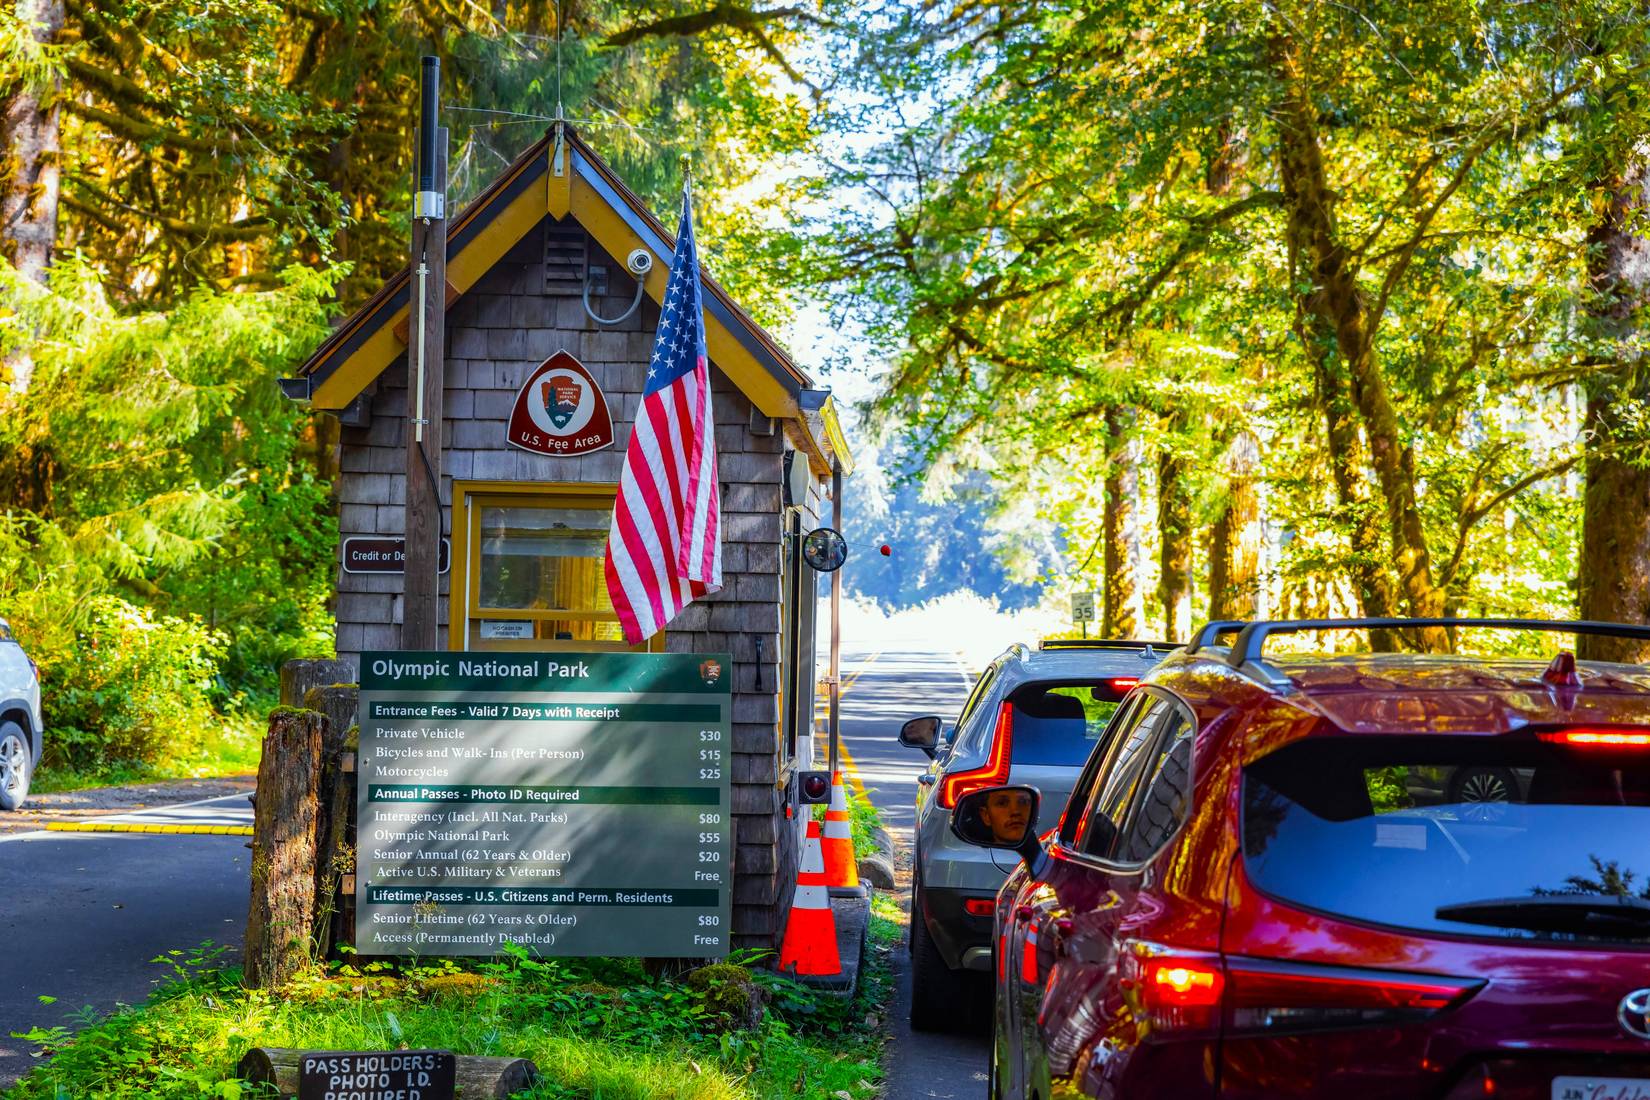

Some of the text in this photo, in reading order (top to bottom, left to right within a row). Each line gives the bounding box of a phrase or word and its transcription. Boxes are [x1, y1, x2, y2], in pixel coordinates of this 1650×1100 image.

[521, 432, 601, 449] U.S. Fee Area
[352, 550, 405, 560] Credit or De
[1075, 608, 1092, 619] 35
[372, 660, 589, 680] Olympic National Park
[375, 706, 428, 716] Entrance
[431, 706, 457, 717] Fees
[468, 706, 499, 718] Valid
[502, 706, 509, 718] 7
[512, 706, 542, 719] Days
[544, 706, 572, 718] with
[576, 706, 620, 720] Receipt
[376, 728, 465, 739] Private Vehicle
[700, 730, 721, 742] $30
[376, 747, 584, 760] Bicycles and Walk- Ins (Per Person)
[700, 750, 721, 761] $15
[376, 766, 449, 779] Motorcycles
[700, 768, 721, 780] $25
[374, 788, 418, 800] Annual
[420, 789, 460, 800] Passes
[471, 789, 506, 800] Photo
[510, 790, 522, 800] ID
[526, 790, 580, 802] Required
[374, 811, 568, 825] Interagency (Incl. All Nat. Parks)
[699, 813, 720, 825] $80
[374, 830, 510, 844] Olympic National Park
[699, 832, 720, 844] $55
[374, 850, 571, 863] Senior Annual (62 Years & Older)
[699, 852, 720, 863] $20
[376, 866, 561, 880] Active U.S. Military & Veterans
[694, 871, 720, 882] Free
[373, 891, 421, 902] Lifetime
[425, 892, 463, 902] Passes
[474, 892, 498, 902] U.S.
[502, 892, 548, 903] Citizens
[552, 892, 574, 903] and
[578, 892, 612, 903] Perm.
[616, 892, 673, 904] Residents
[373, 914, 577, 927] Senior Lifetime (62 Years & Older)
[698, 915, 720, 927] $80
[373, 932, 555, 946] Access (Permanently Disabled)
[694, 934, 719, 945] Free
[305, 1055, 442, 1074] PASS HOLDERS:
[330, 1072, 432, 1090] PHOTO I.D.
